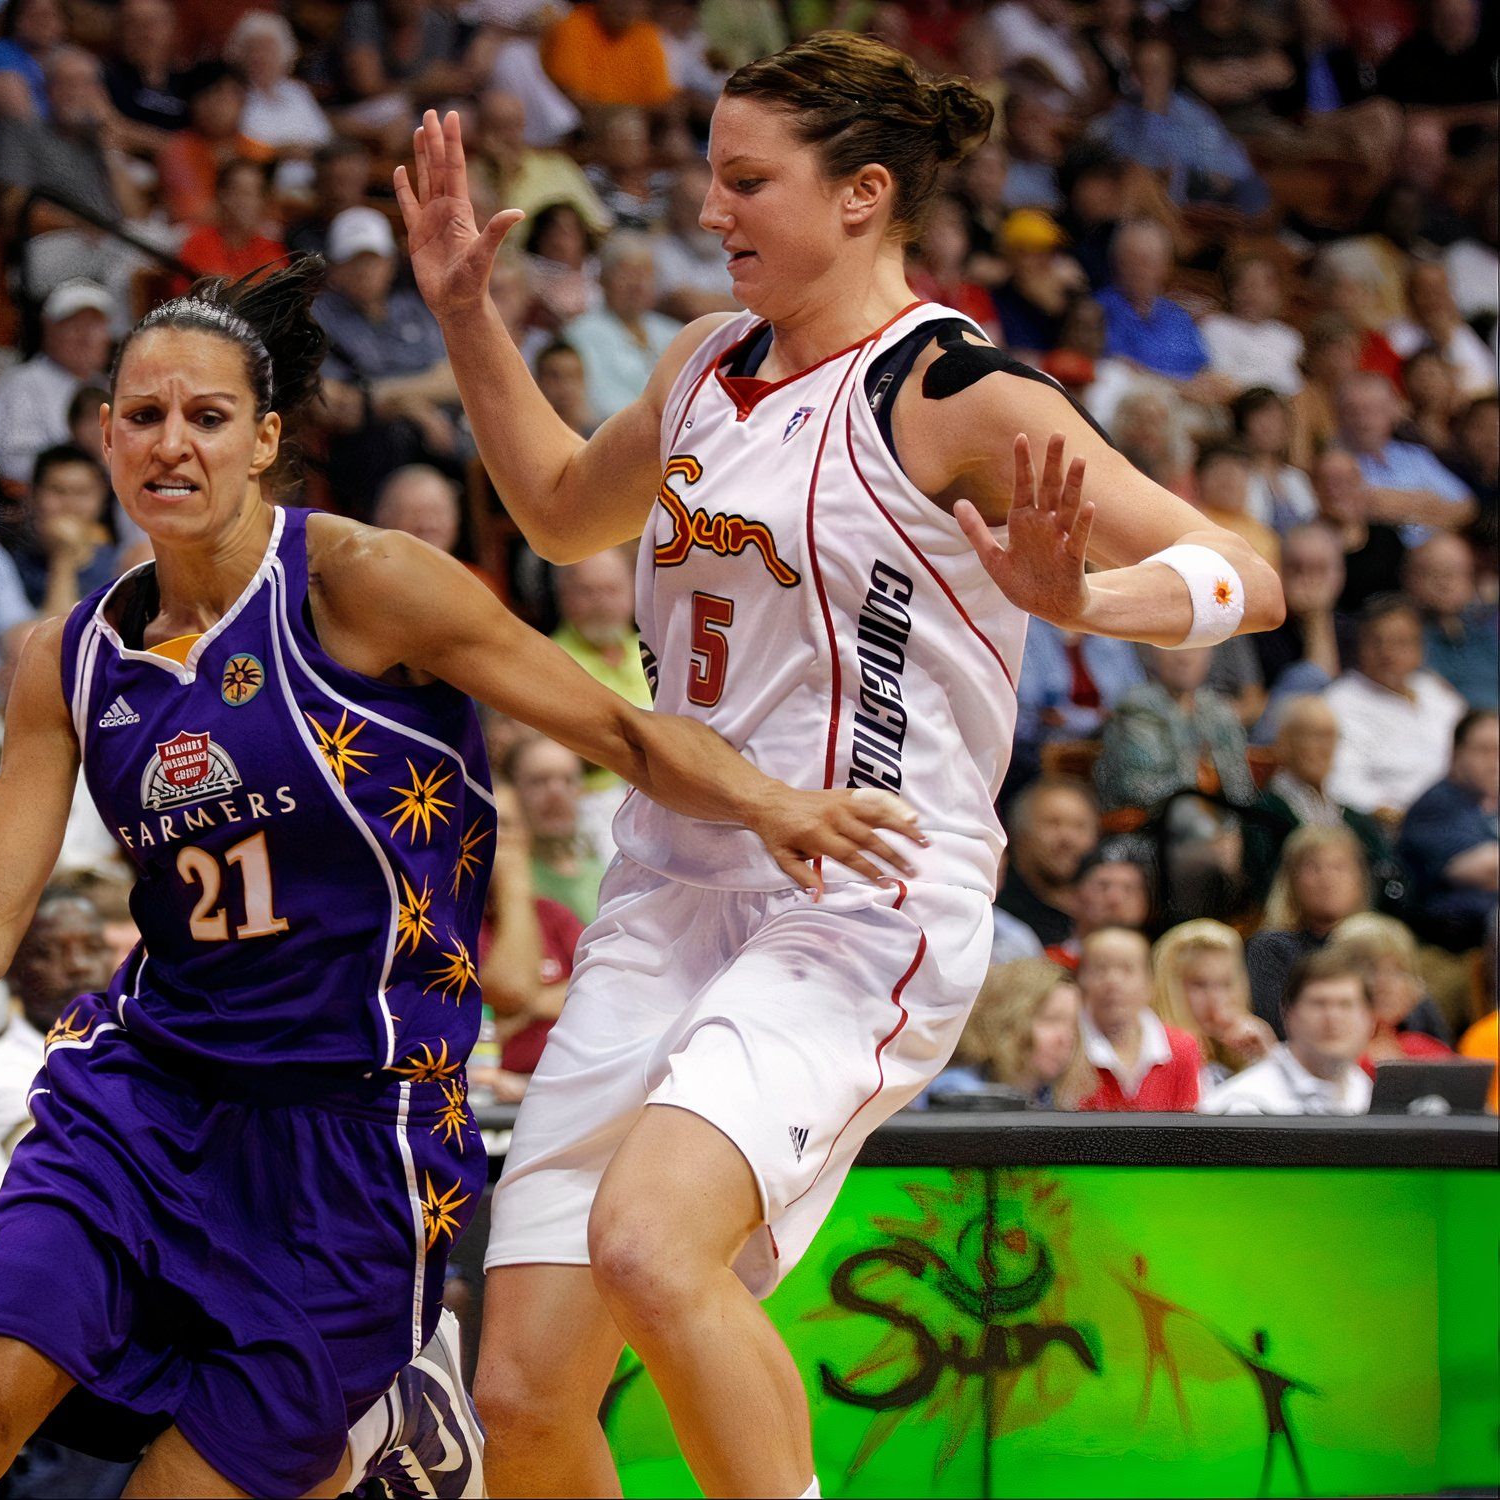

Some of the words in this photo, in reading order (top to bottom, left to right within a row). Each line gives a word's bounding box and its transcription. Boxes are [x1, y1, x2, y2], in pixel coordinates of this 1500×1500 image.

[655, 454, 801, 588] Sun
[686, 590, 734, 708] 5
[117, 785, 297, 849] FARMERS
[175, 829, 290, 942] 21
[818, 1245, 1103, 1411] Sun
